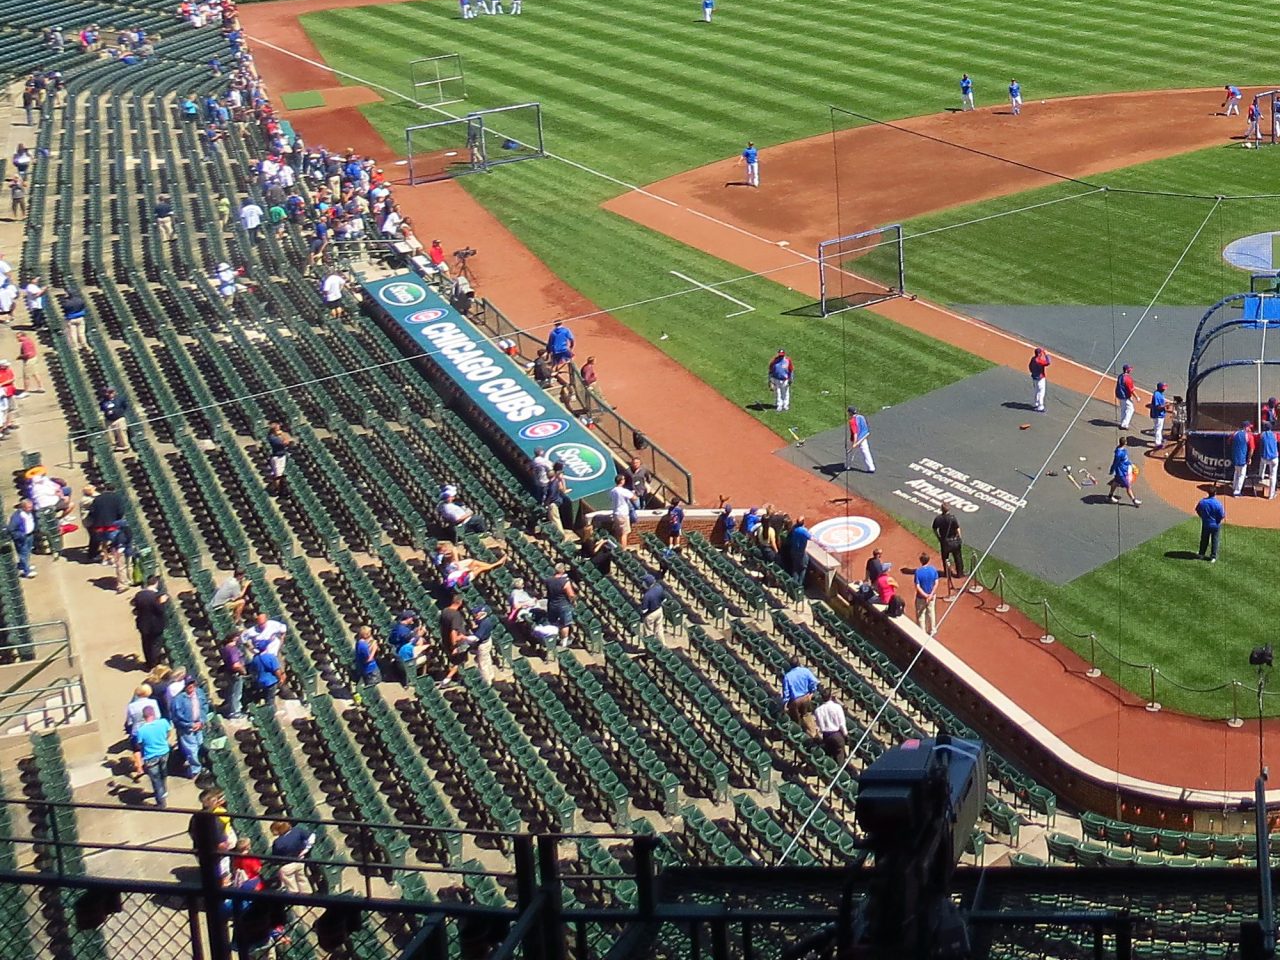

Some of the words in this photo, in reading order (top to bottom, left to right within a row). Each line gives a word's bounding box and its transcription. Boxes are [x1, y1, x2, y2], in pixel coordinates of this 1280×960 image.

[421, 322, 503, 381] CHICAGO
[478, 378, 546, 422] CUBS
[555, 448, 593, 477] Scotts
[919, 457, 944, 473] THE
[904, 479, 980, 513] ATHLETICO
